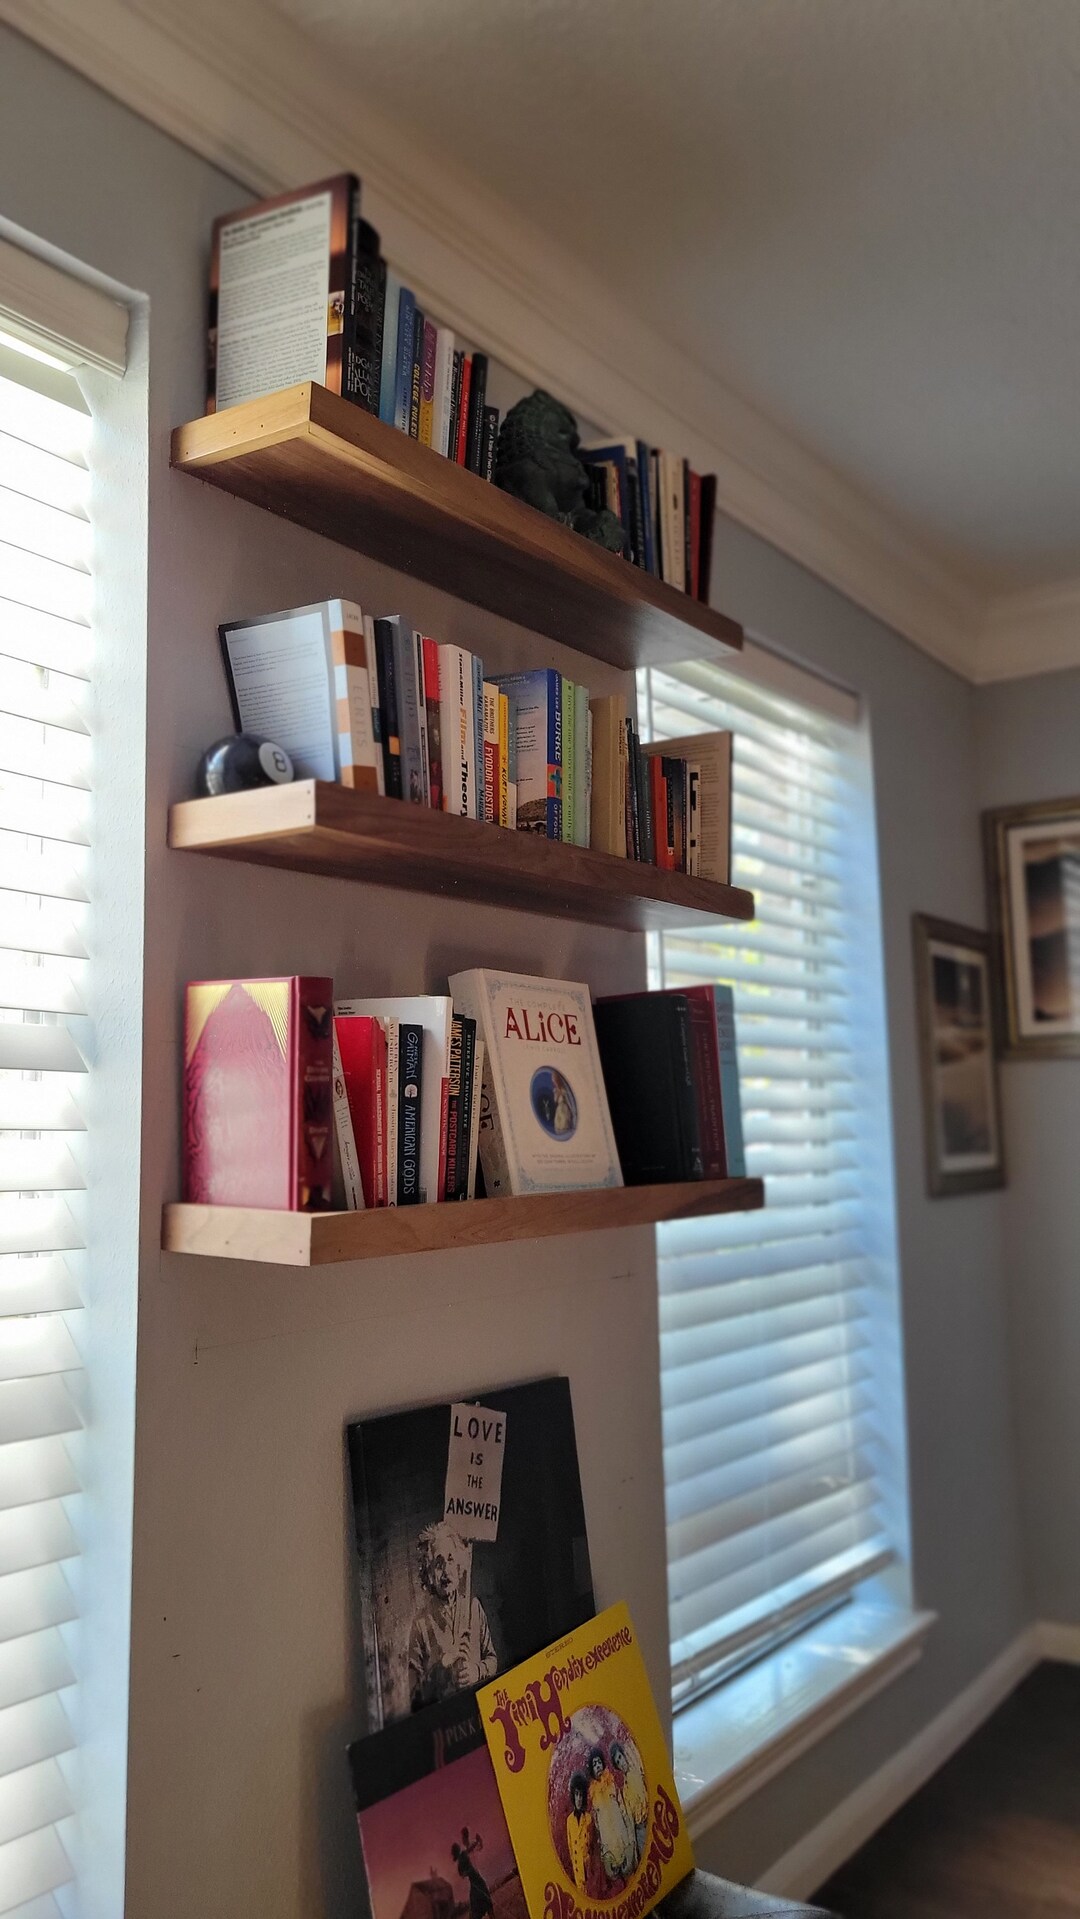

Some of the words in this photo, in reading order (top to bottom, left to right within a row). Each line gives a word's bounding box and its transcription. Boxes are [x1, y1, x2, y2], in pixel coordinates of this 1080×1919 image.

[412, 363, 421, 402] COLLEGE
[459, 707, 468, 744] Film
[272, 751, 287, 772] 8
[485, 747, 494, 783] FYODOR
[459, 761, 469, 818] Theory
[485, 785, 494, 824] DOSTOEV
[450, 1020, 463, 1047] JAMES
[406, 1031, 419, 1080] GAIMAN
[449, 1048, 462, 1096] PATTERSON
[404, 1104, 417, 1156] AMERICAN
[448, 1110, 458, 1156] POSTCARD
[403, 1159, 415, 1194] GODS
[447, 1157, 457, 1193] KILLERS
[454, 1416, 503, 1443] LOVE
[470, 1452, 483, 1466] IS
[467, 1474, 483, 1489] THE
[446, 1497, 498, 1521] ANSWER
[545, 1637, 573, 1659] STEREO
[493, 1688, 509, 1706] THE
[445, 1718, 477, 1747] PINK
